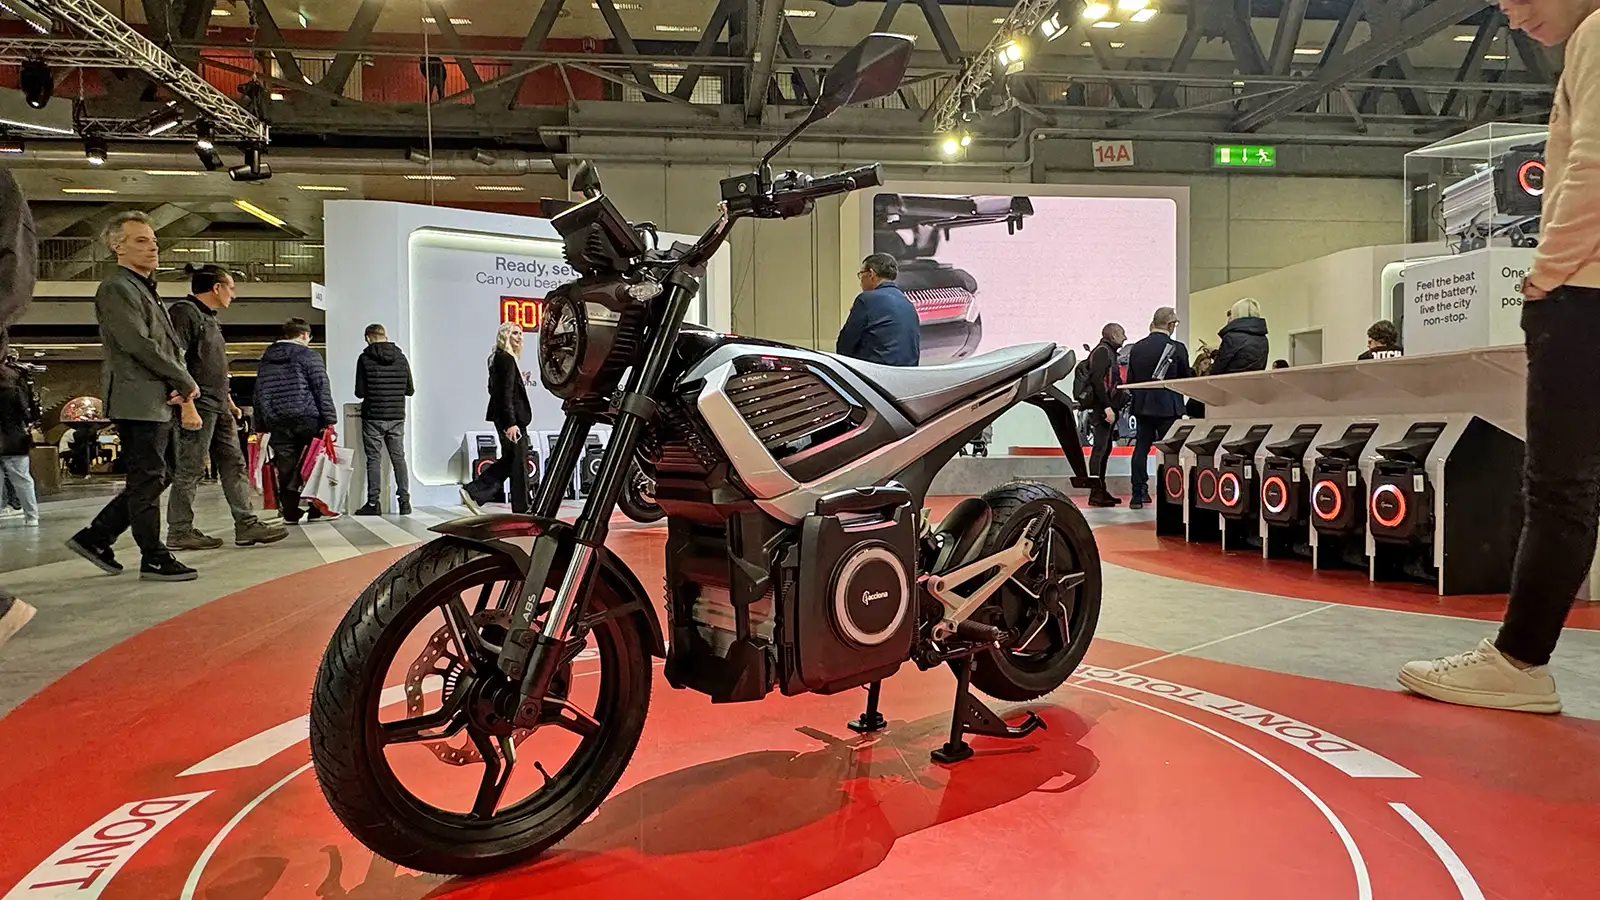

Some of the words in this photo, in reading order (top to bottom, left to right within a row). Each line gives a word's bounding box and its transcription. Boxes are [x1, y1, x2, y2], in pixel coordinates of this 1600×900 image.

[1095, 145, 1131, 163] 14A
[495, 256, 549, 277] Ready,
[1501, 266, 1525, 278] One
[476, 271, 503, 285] Can
[506, 276, 531, 288] you
[1416, 278, 1435, 291] Feel
[1436, 276, 1451, 287] the
[1453, 271, 1475, 284] beat
[1414, 293, 1424, 304] of
[1424, 292, 1440, 302] the
[1420, 305, 1435, 315] live
[1436, 302, 1452, 312] the
[1453, 299, 1471, 310] city
[1423, 313, 1468, 326] non-stop.
[867, 591, 889, 601] acciona
[522, 594, 537, 622] ABS
[1206, 704, 1360, 752] DON'T
[28, 800, 190, 890] DON'T
